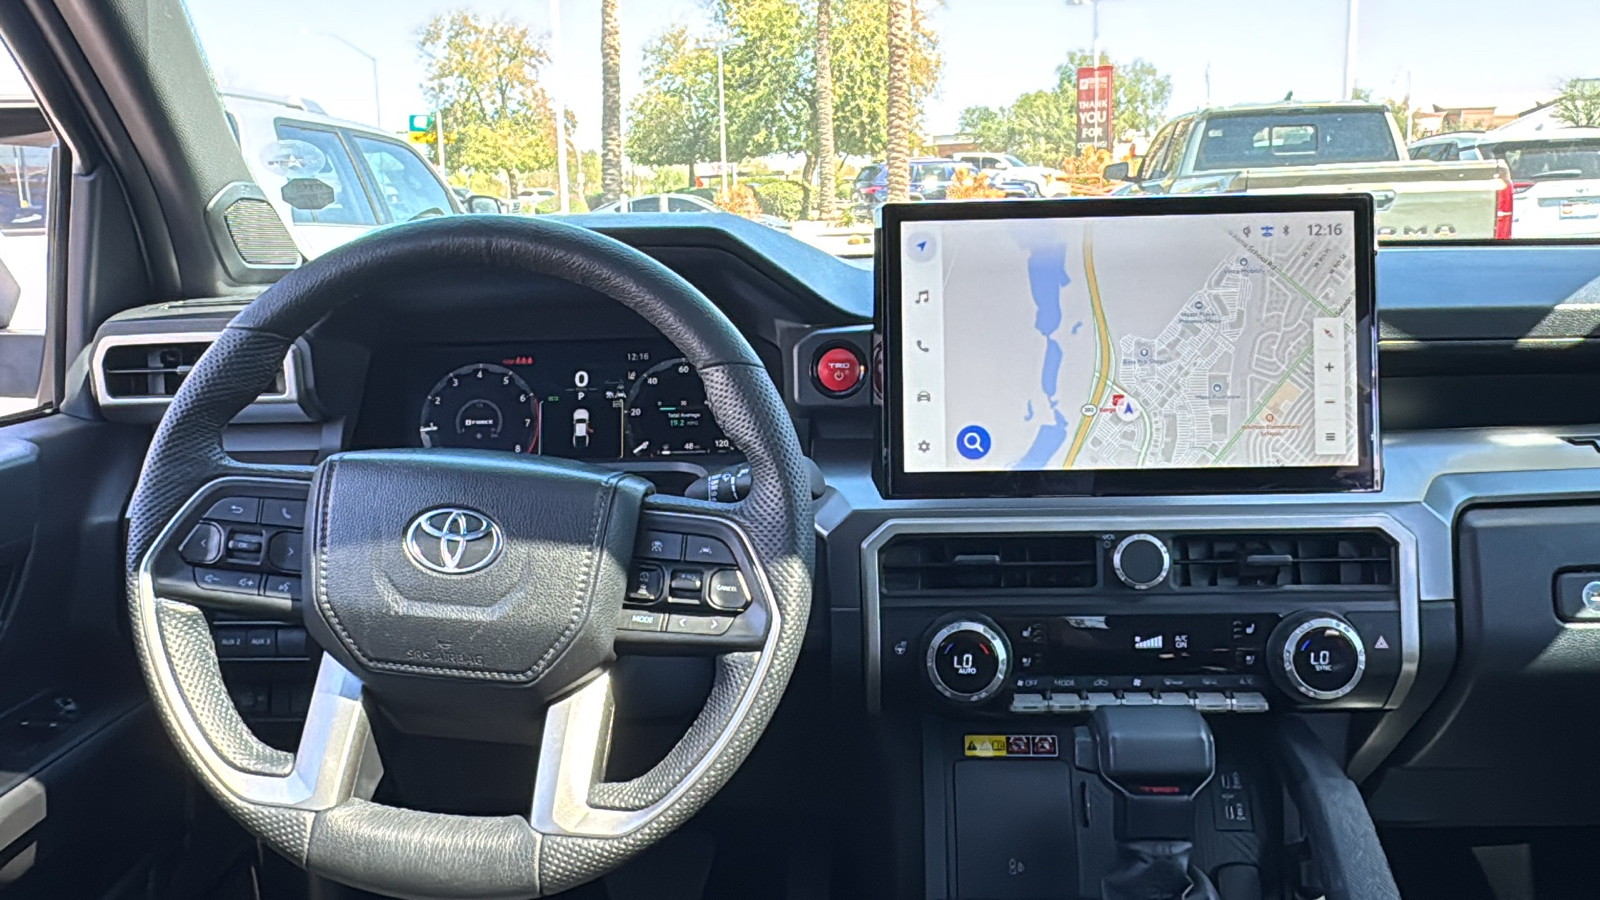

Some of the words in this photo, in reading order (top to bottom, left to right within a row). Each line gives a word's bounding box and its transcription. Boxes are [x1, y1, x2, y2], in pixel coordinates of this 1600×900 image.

[1078, 99, 1108, 110] THANK
[1079, 110, 1107, 124] YOU
[1082, 127, 1103, 138] FOR
[1307, 223, 1343, 236] 12:16
[627, 352, 649, 361] 12:16
[678, 365, 690, 373] 60
[476, 370, 483, 379] 4
[574, 370, 589, 387] 0
[452, 378, 459, 387] 3
[503, 376, 509, 385] 5
[647, 377, 658, 385] 40
[519, 394, 526, 402] 6
[577, 391, 585, 400] P
[434, 396, 441, 405] 2
[630, 408, 641, 416] 20
[524, 418, 531, 427] 7
[515, 444, 521, 453] 8
[716, 584, 737, 592] CANCEL
[631, 614, 654, 624] MODE
[957, 667, 977, 675] AUTO
[1025, 679, 1038, 687] OFF
[1054, 679, 1075, 687] MODE
